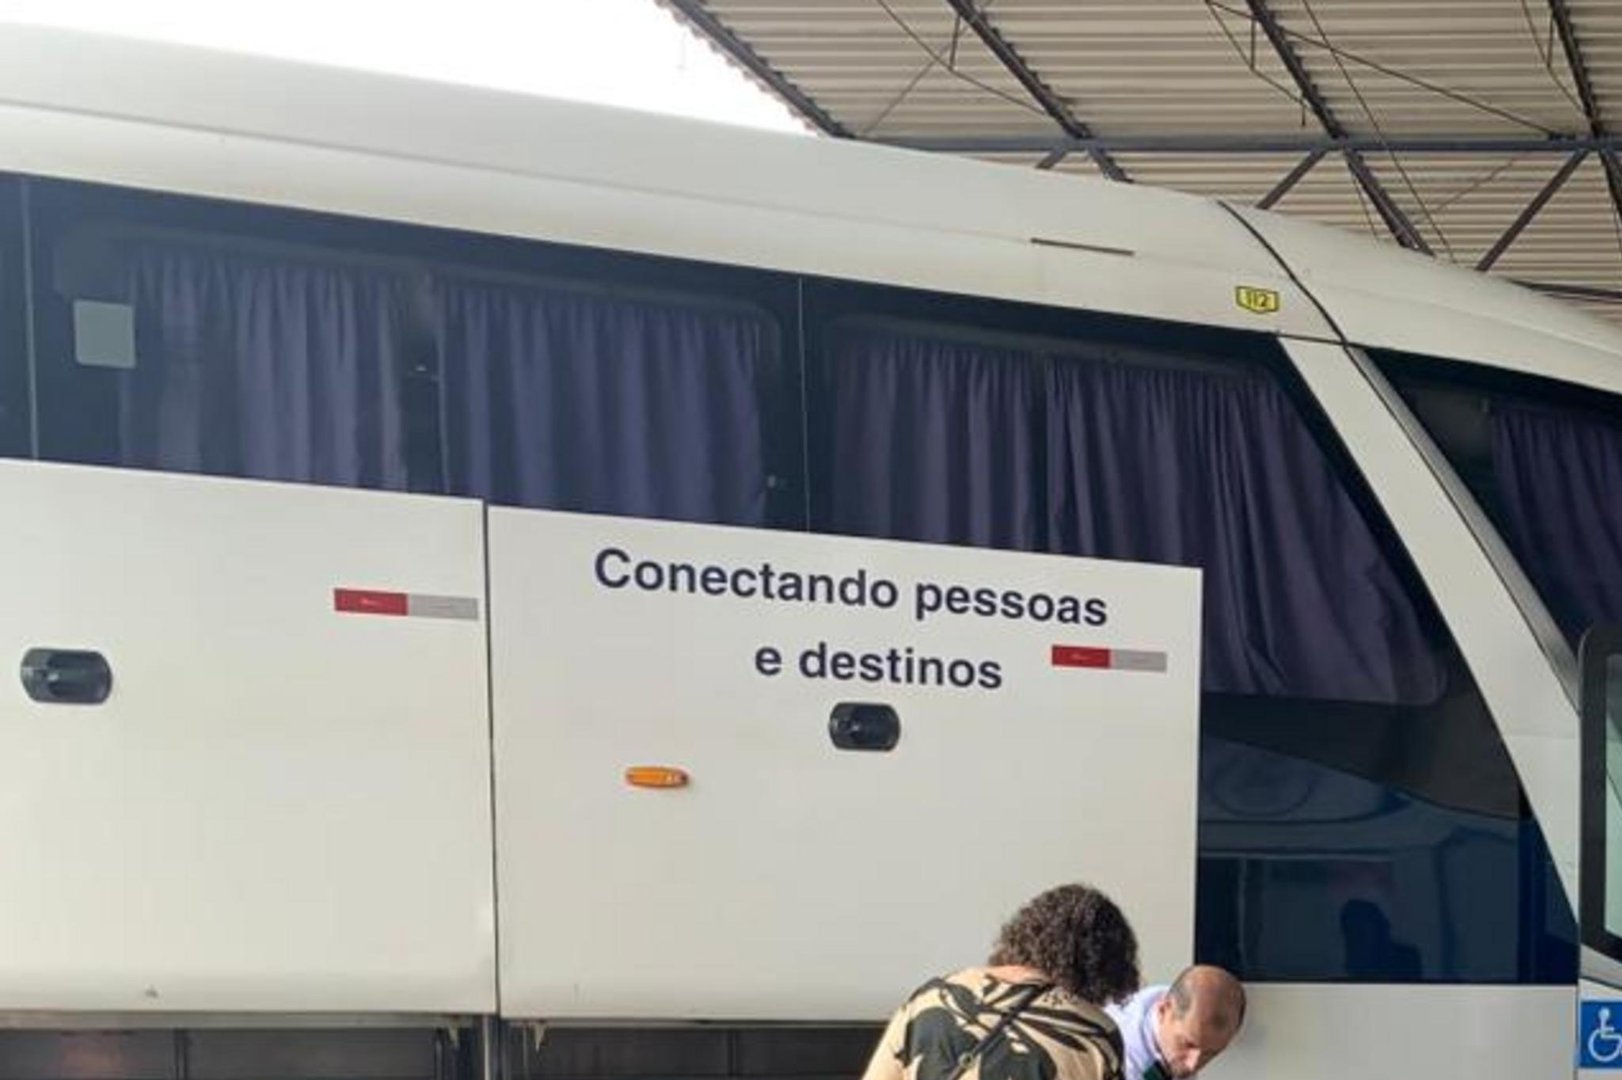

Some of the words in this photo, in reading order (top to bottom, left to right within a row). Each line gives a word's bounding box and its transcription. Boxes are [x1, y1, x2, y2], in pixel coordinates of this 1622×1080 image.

[594, 548, 899, 608] Conectando
[914, 579, 1108, 627] pessoas
[754, 645, 782, 676] e
[798, 641, 1004, 690] destinos
